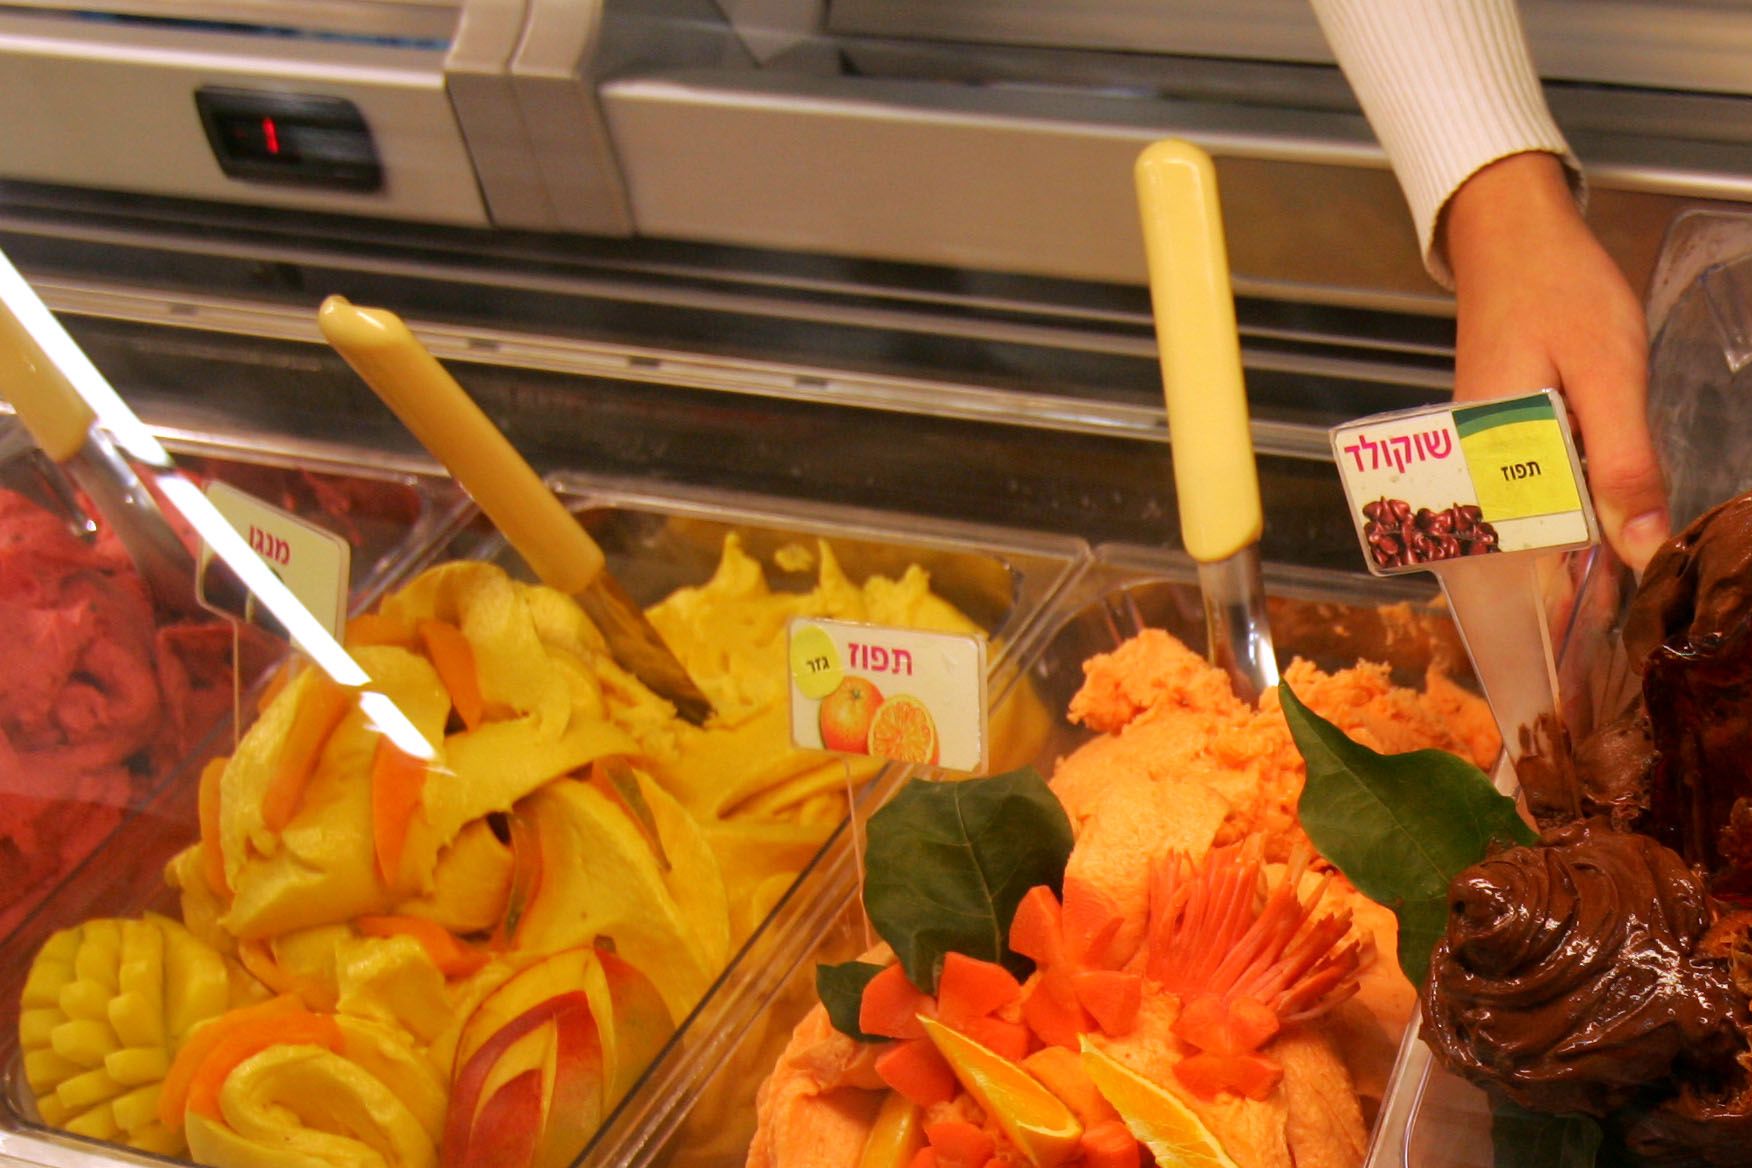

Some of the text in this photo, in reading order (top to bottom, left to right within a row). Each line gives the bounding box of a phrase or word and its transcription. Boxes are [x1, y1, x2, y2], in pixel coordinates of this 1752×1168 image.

[1344, 428, 1452, 473] שוקולד
[1501, 461, 1542, 482] תפוז
[250, 524, 291, 565] מנגו
[806, 656, 830, 673] גזר
[848, 643, 913, 676] תפוז
